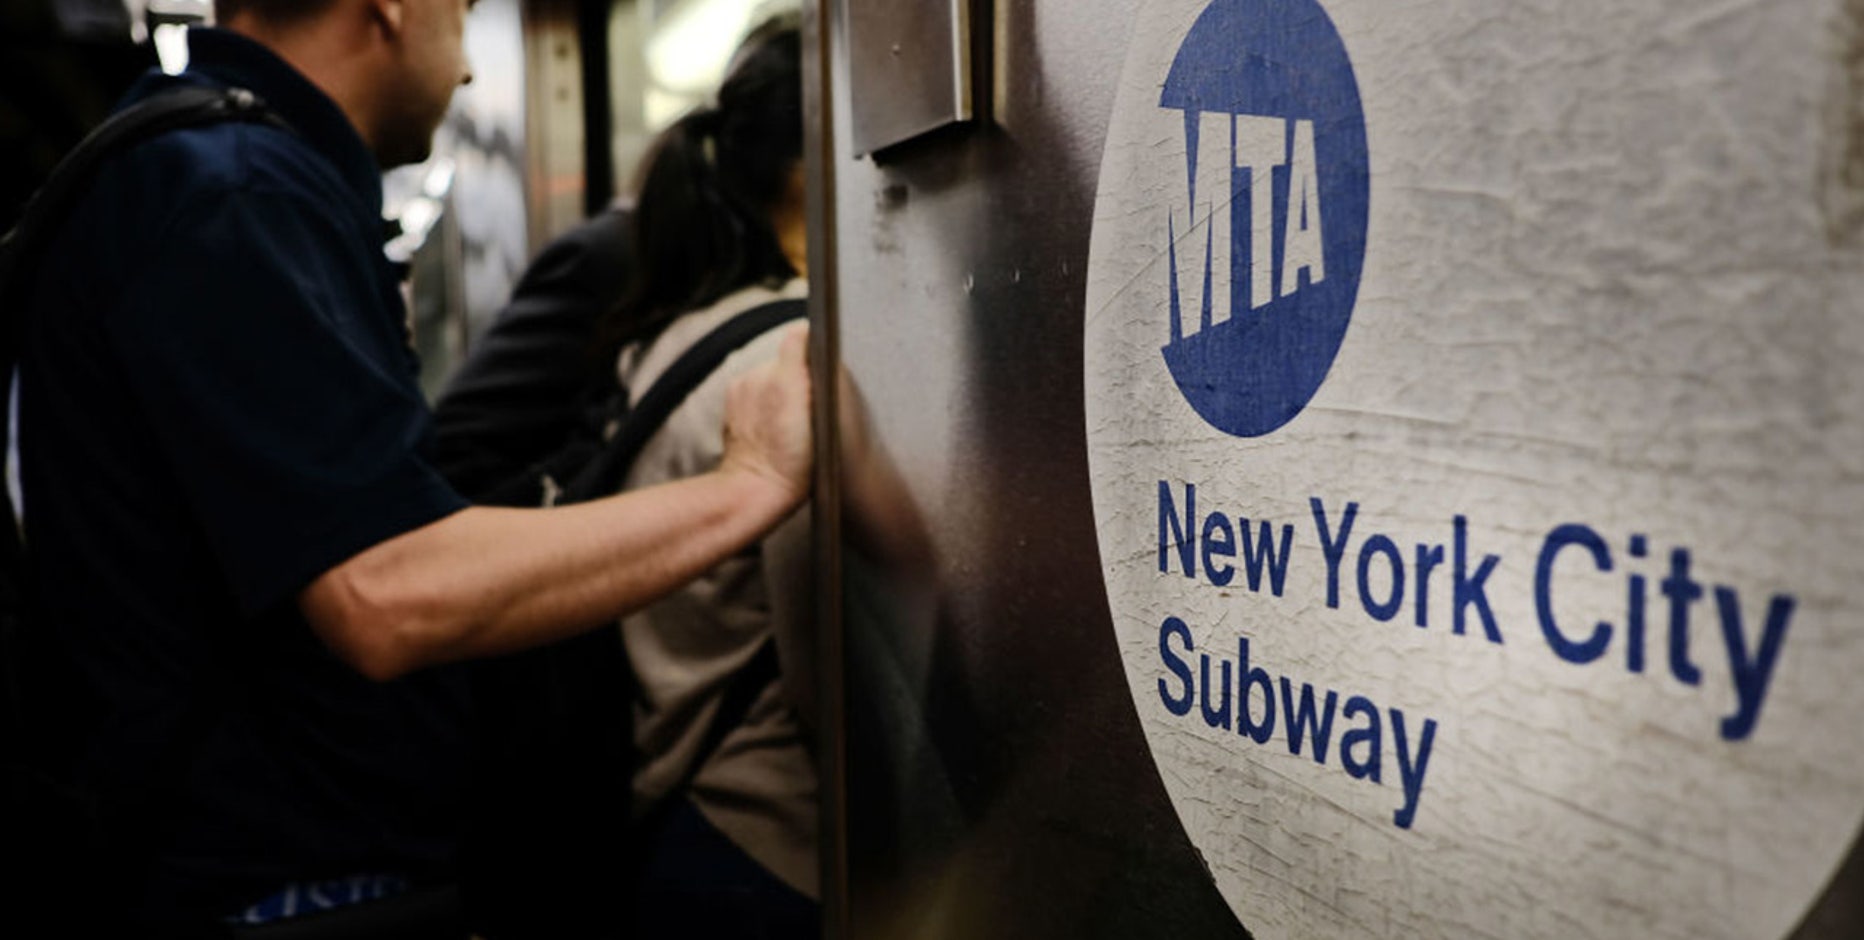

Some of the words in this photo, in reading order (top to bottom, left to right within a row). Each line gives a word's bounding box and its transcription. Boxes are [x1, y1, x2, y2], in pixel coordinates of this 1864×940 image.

[1166, 109, 1327, 343] MTA
[1159, 482, 1293, 597] New
[1311, 498, 1504, 644] York
[1534, 524, 1792, 740] City
[1159, 618, 1437, 828] Subway
